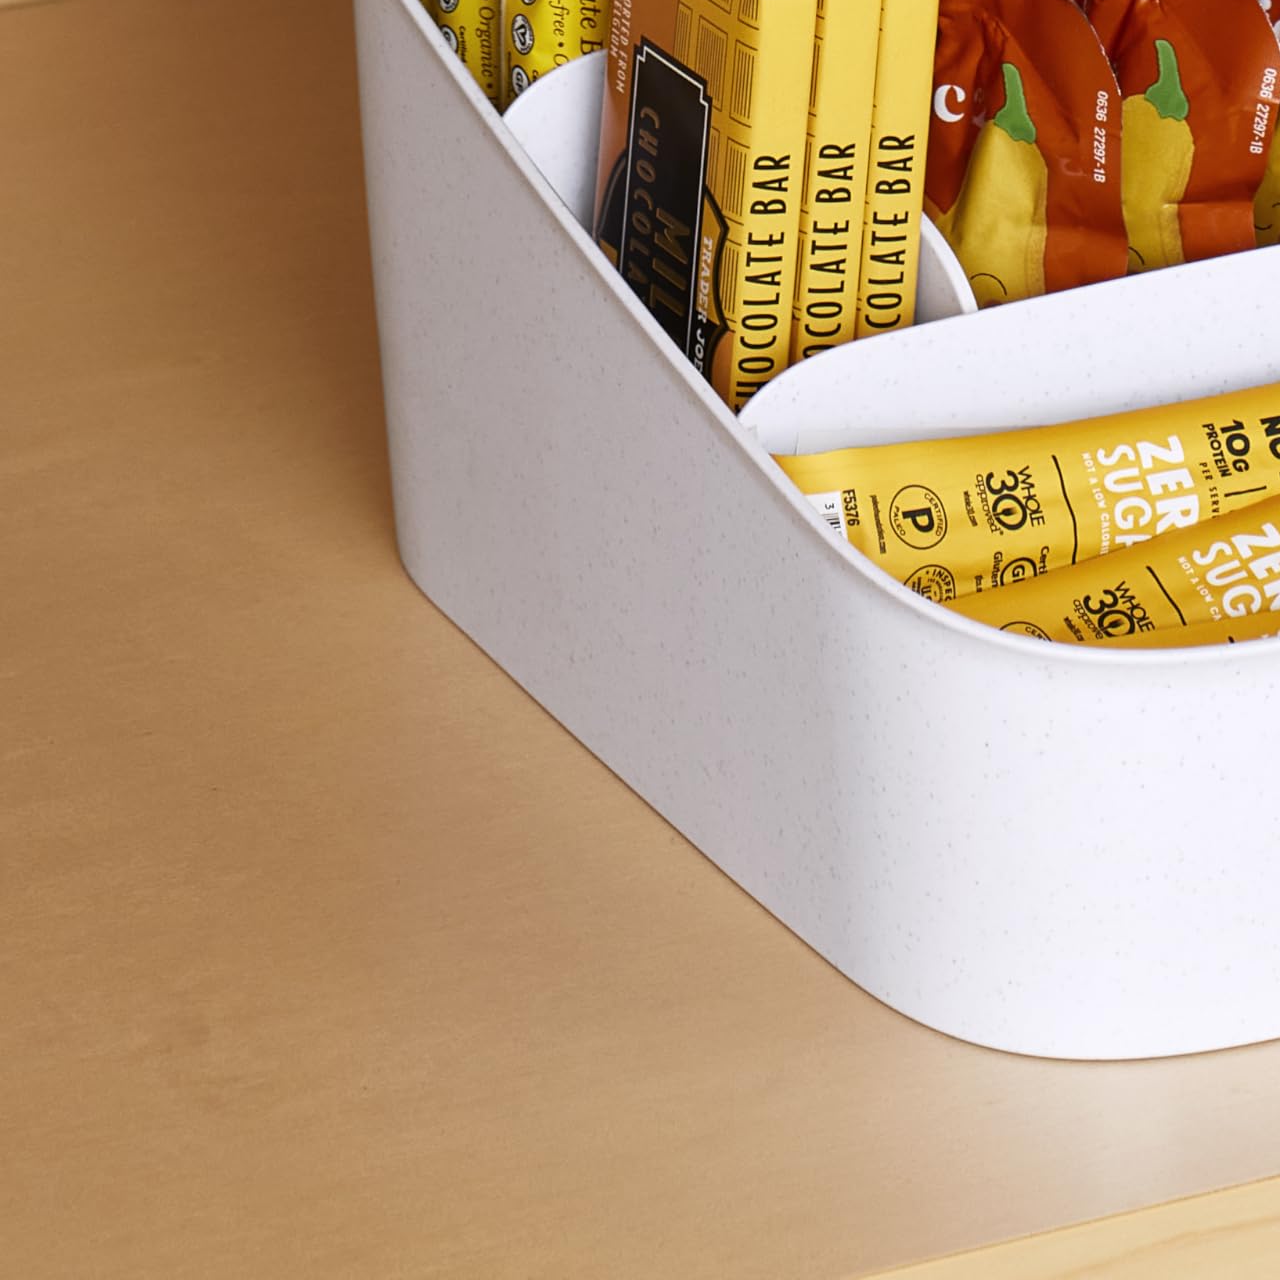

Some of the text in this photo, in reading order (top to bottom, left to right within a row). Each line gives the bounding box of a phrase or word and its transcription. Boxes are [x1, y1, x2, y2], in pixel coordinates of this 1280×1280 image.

[475, 6, 495, 78] Organic
[616, 51, 628, 94] FROM
[1260, 68, 1277, 99] 0636
[1096, 91, 1109, 122] 0636
[815, 143, 856, 203] BAR
[875, 134, 915, 194] BAR
[735, 154, 791, 414] HOCOLATE BAR
[1202, 423, 1232, 477] PROTEIN
[1018, 465, 1045, 527] WHOLE
[1081, 452, 1097, 473] NOT
[1094, 488, 1107, 509] LOW
[1200, 462, 1220, 519] PER SERV
[842, 488, 860, 526] F5376
[893, 505, 906, 536] PALEO
[924, 493, 943, 537] CERTIFIED
[992, 551, 1003, 588] Gluten
[1114, 581, 1155, 632] WHOLE
